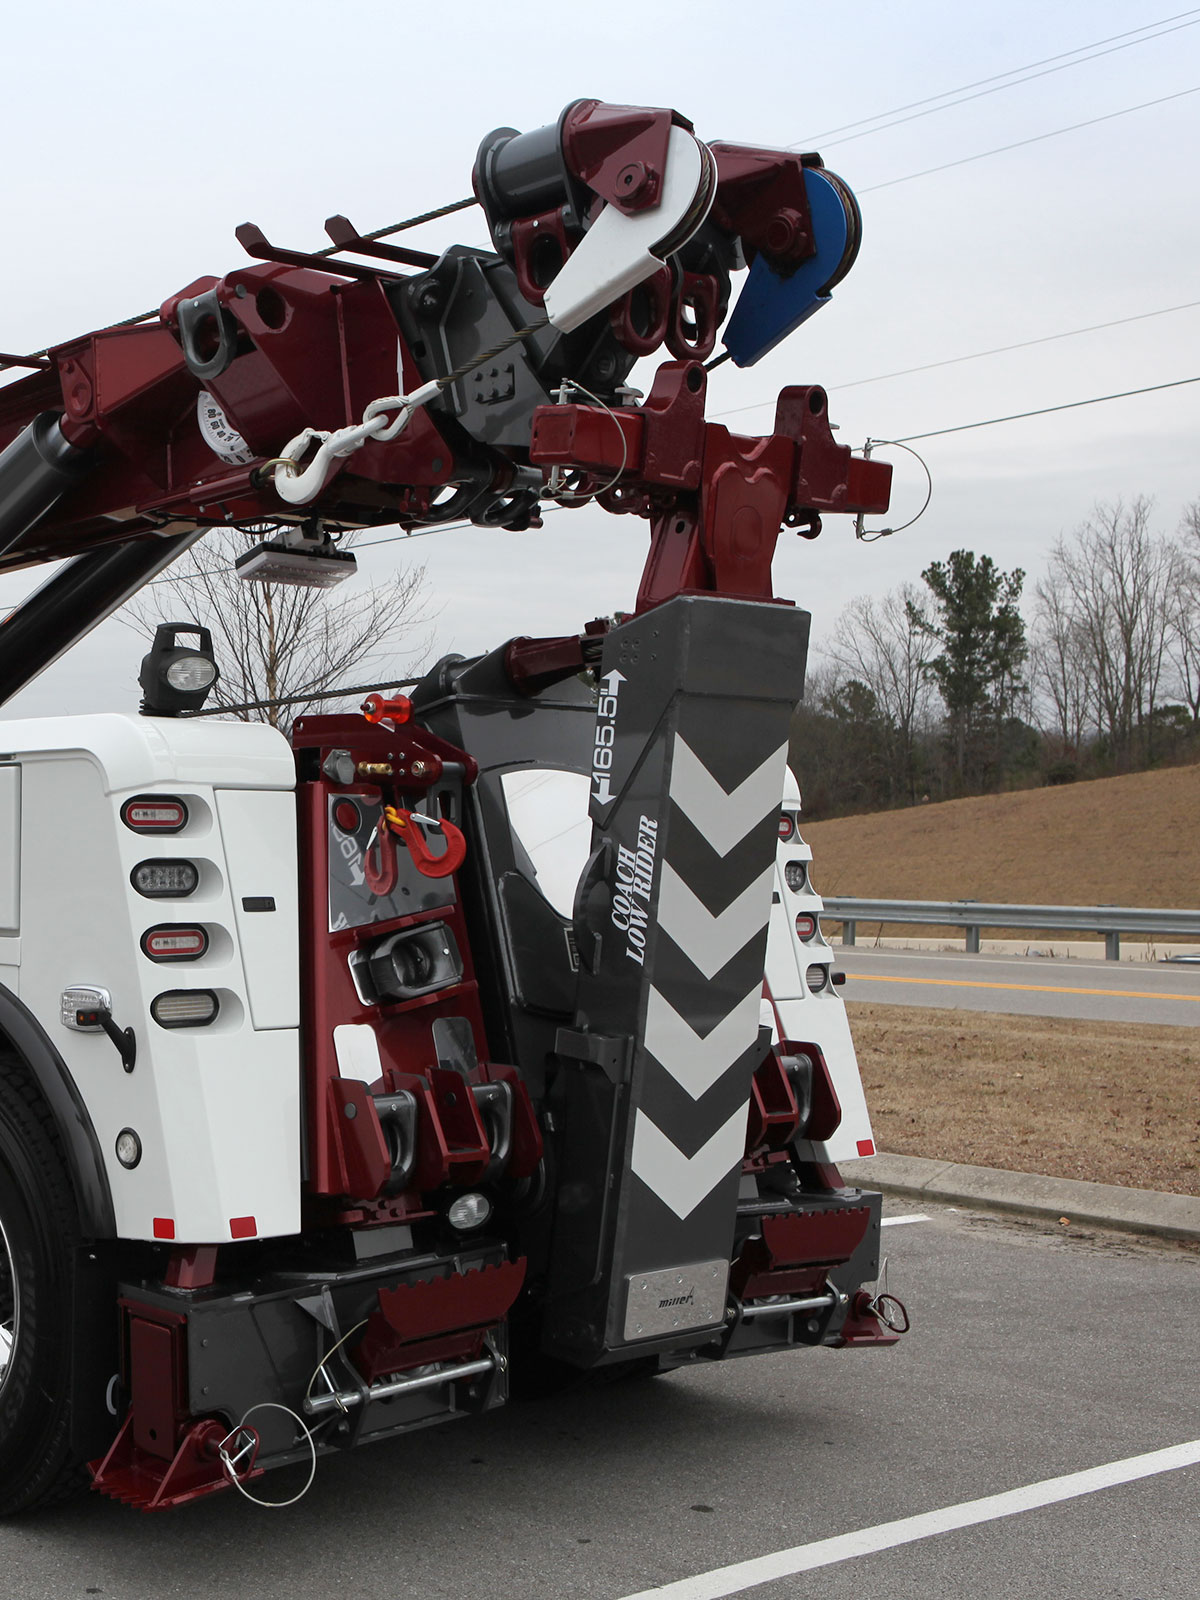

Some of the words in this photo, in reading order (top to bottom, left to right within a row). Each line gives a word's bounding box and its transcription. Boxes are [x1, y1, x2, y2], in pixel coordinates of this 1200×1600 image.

[611, 843, 637, 931] COACH
[632, 814, 658, 902] RIDER
[626, 898, 649, 967] LOW
